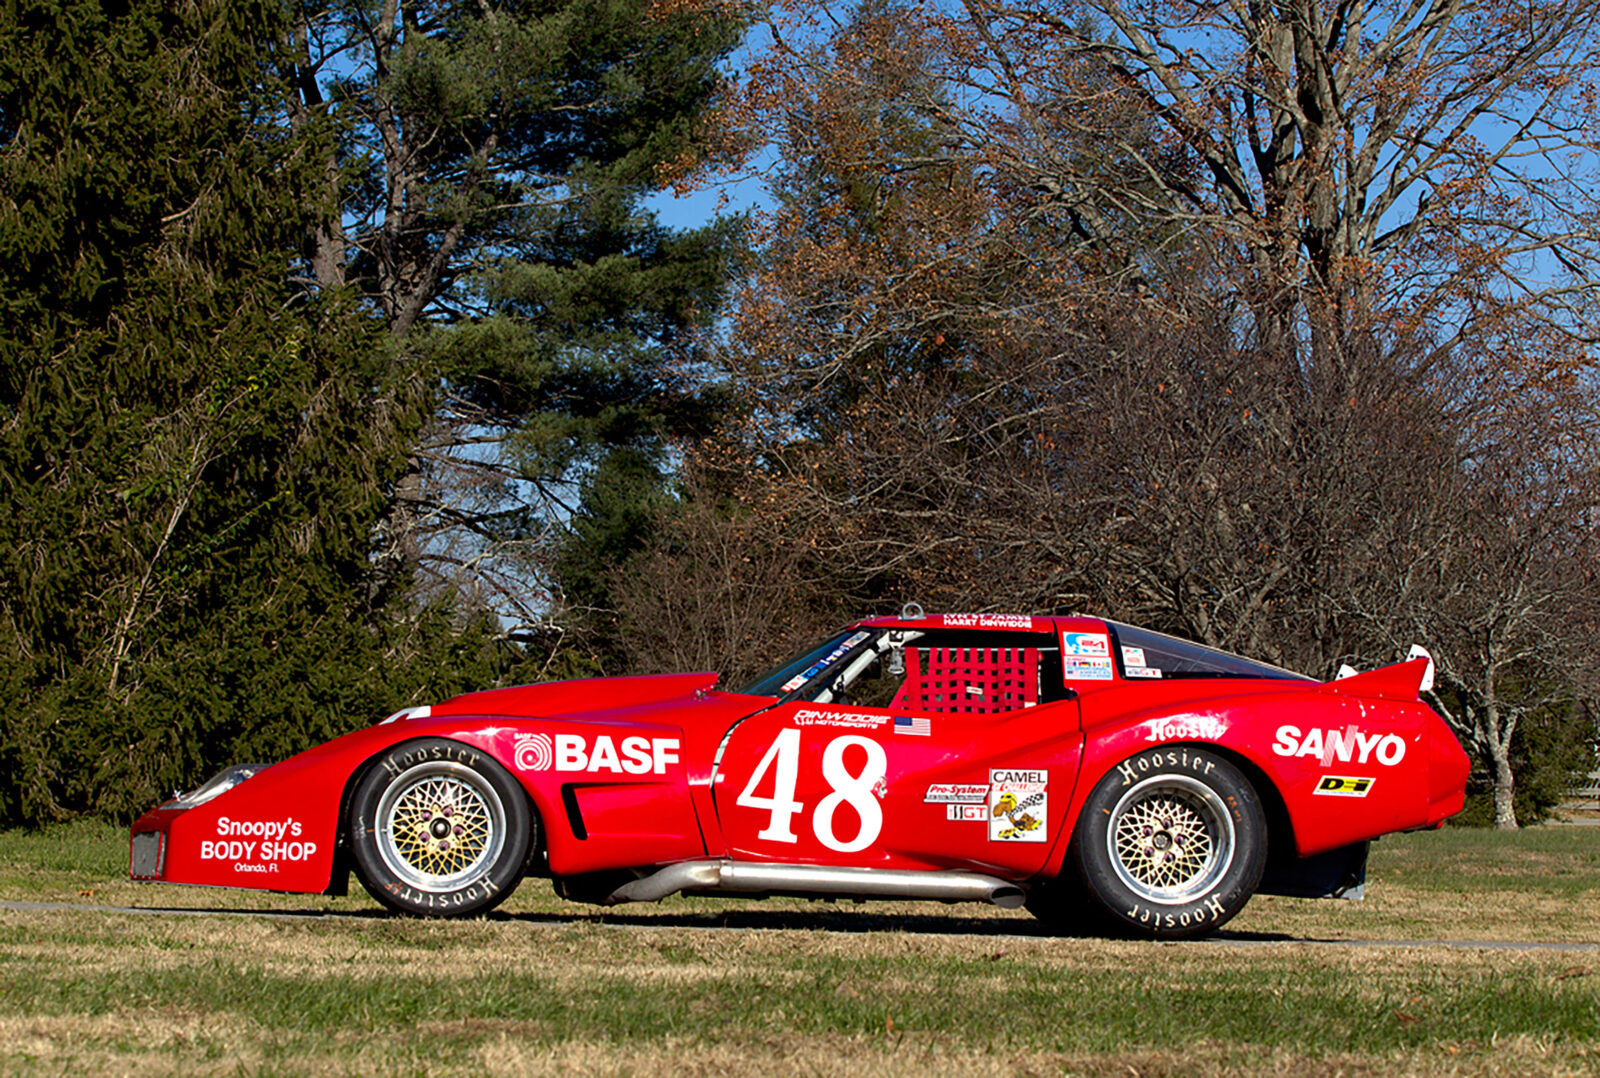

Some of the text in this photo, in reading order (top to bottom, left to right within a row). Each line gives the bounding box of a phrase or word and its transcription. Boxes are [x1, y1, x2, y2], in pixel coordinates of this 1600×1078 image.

[944, 618, 1032, 629] HARRY DINWIDDIE
[795, 709, 891, 725] DINWIDDIE
[814, 719, 879, 730] MOTORSPORTS
[554, 733, 681, 775] BASF
[1272, 724, 1406, 767] SANYO
[381, 746, 480, 780] Hoosier
[1117, 748, 1215, 786] Hoosier
[736, 727, 888, 853] 48
[930, 784, 987, 796] Pro-System
[993, 771, 1046, 784] CAMEL
[216, 816, 302, 841] Snoopy's
[200, 841, 317, 861] BODY SHOP
[234, 862, 268, 873] Orlando,
[400, 871, 499, 911] Hoosier
[1127, 893, 1226, 931] Hoosier
